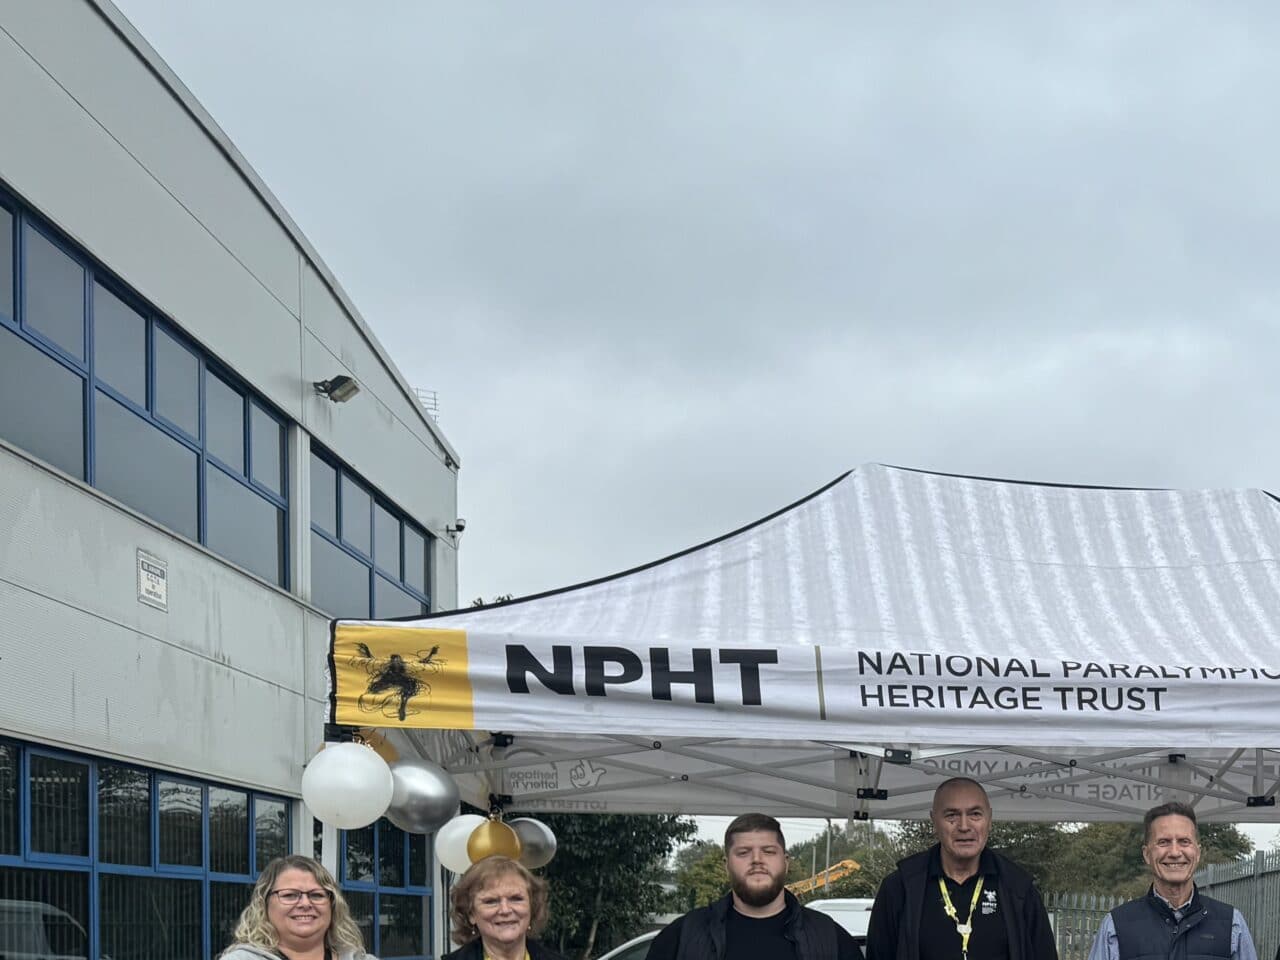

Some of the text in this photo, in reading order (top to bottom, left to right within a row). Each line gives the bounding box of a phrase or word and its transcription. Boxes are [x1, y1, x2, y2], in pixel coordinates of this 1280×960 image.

[505, 645, 778, 705] NPHT
[858, 652, 1050, 677] NATIONAL
[860, 684, 1167, 712] HERITAGE TRUST
